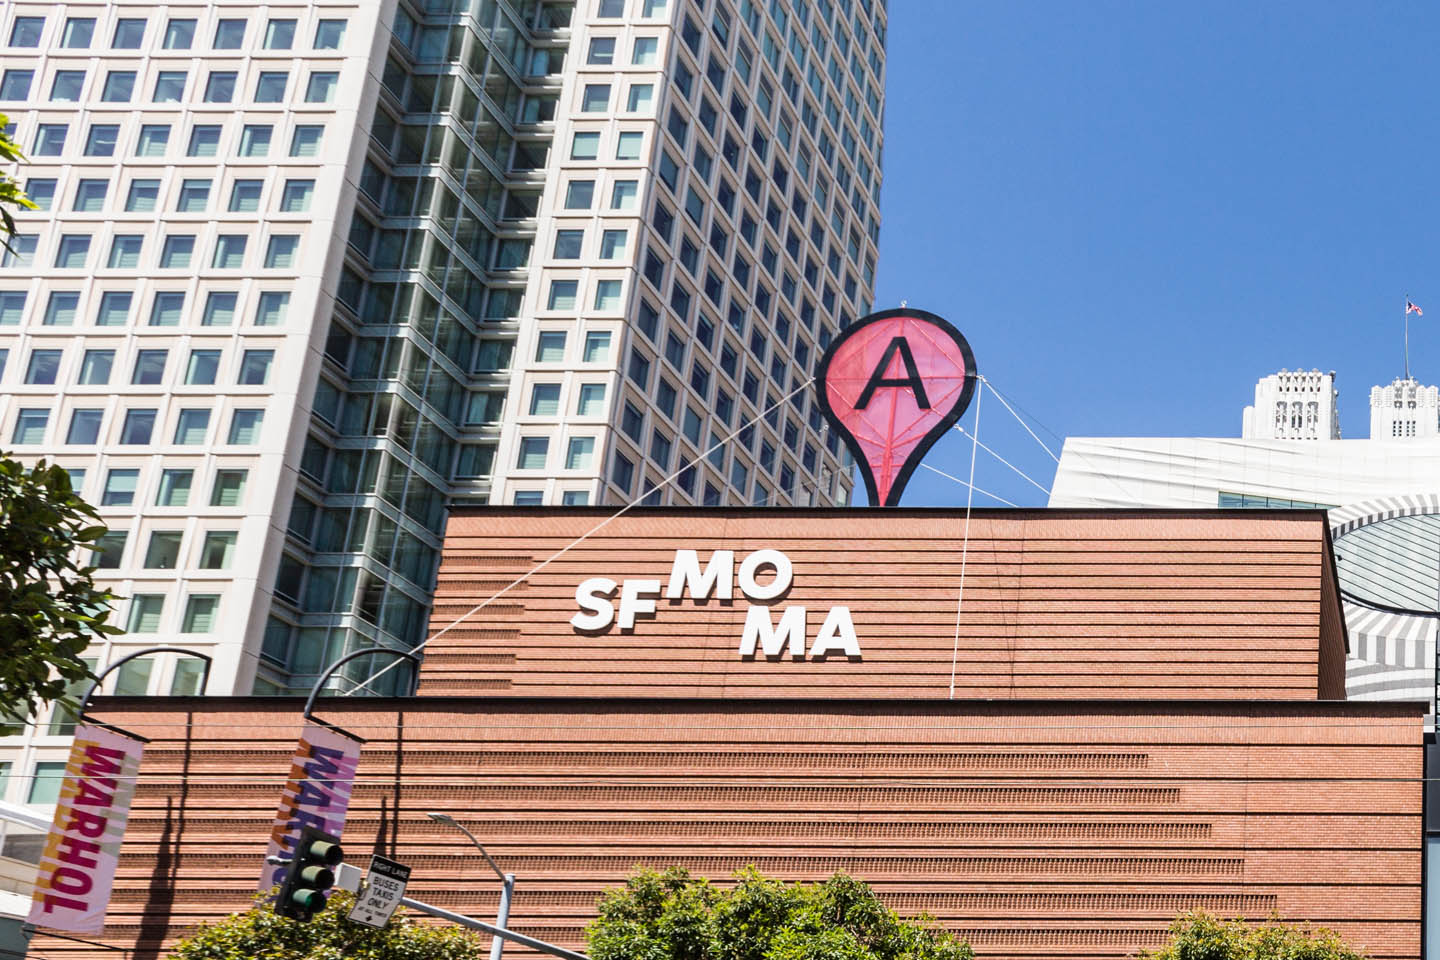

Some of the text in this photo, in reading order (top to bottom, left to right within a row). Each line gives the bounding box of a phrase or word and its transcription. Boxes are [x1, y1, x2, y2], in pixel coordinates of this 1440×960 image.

[854, 336, 931, 410] A
[44, 745, 126, 914] WARHOL
[268, 745, 344, 903] WAR
[367, 897, 390, 909] ONLY
[373, 876, 400, 892] BUSES
[373, 887, 395, 901] TAXIS
